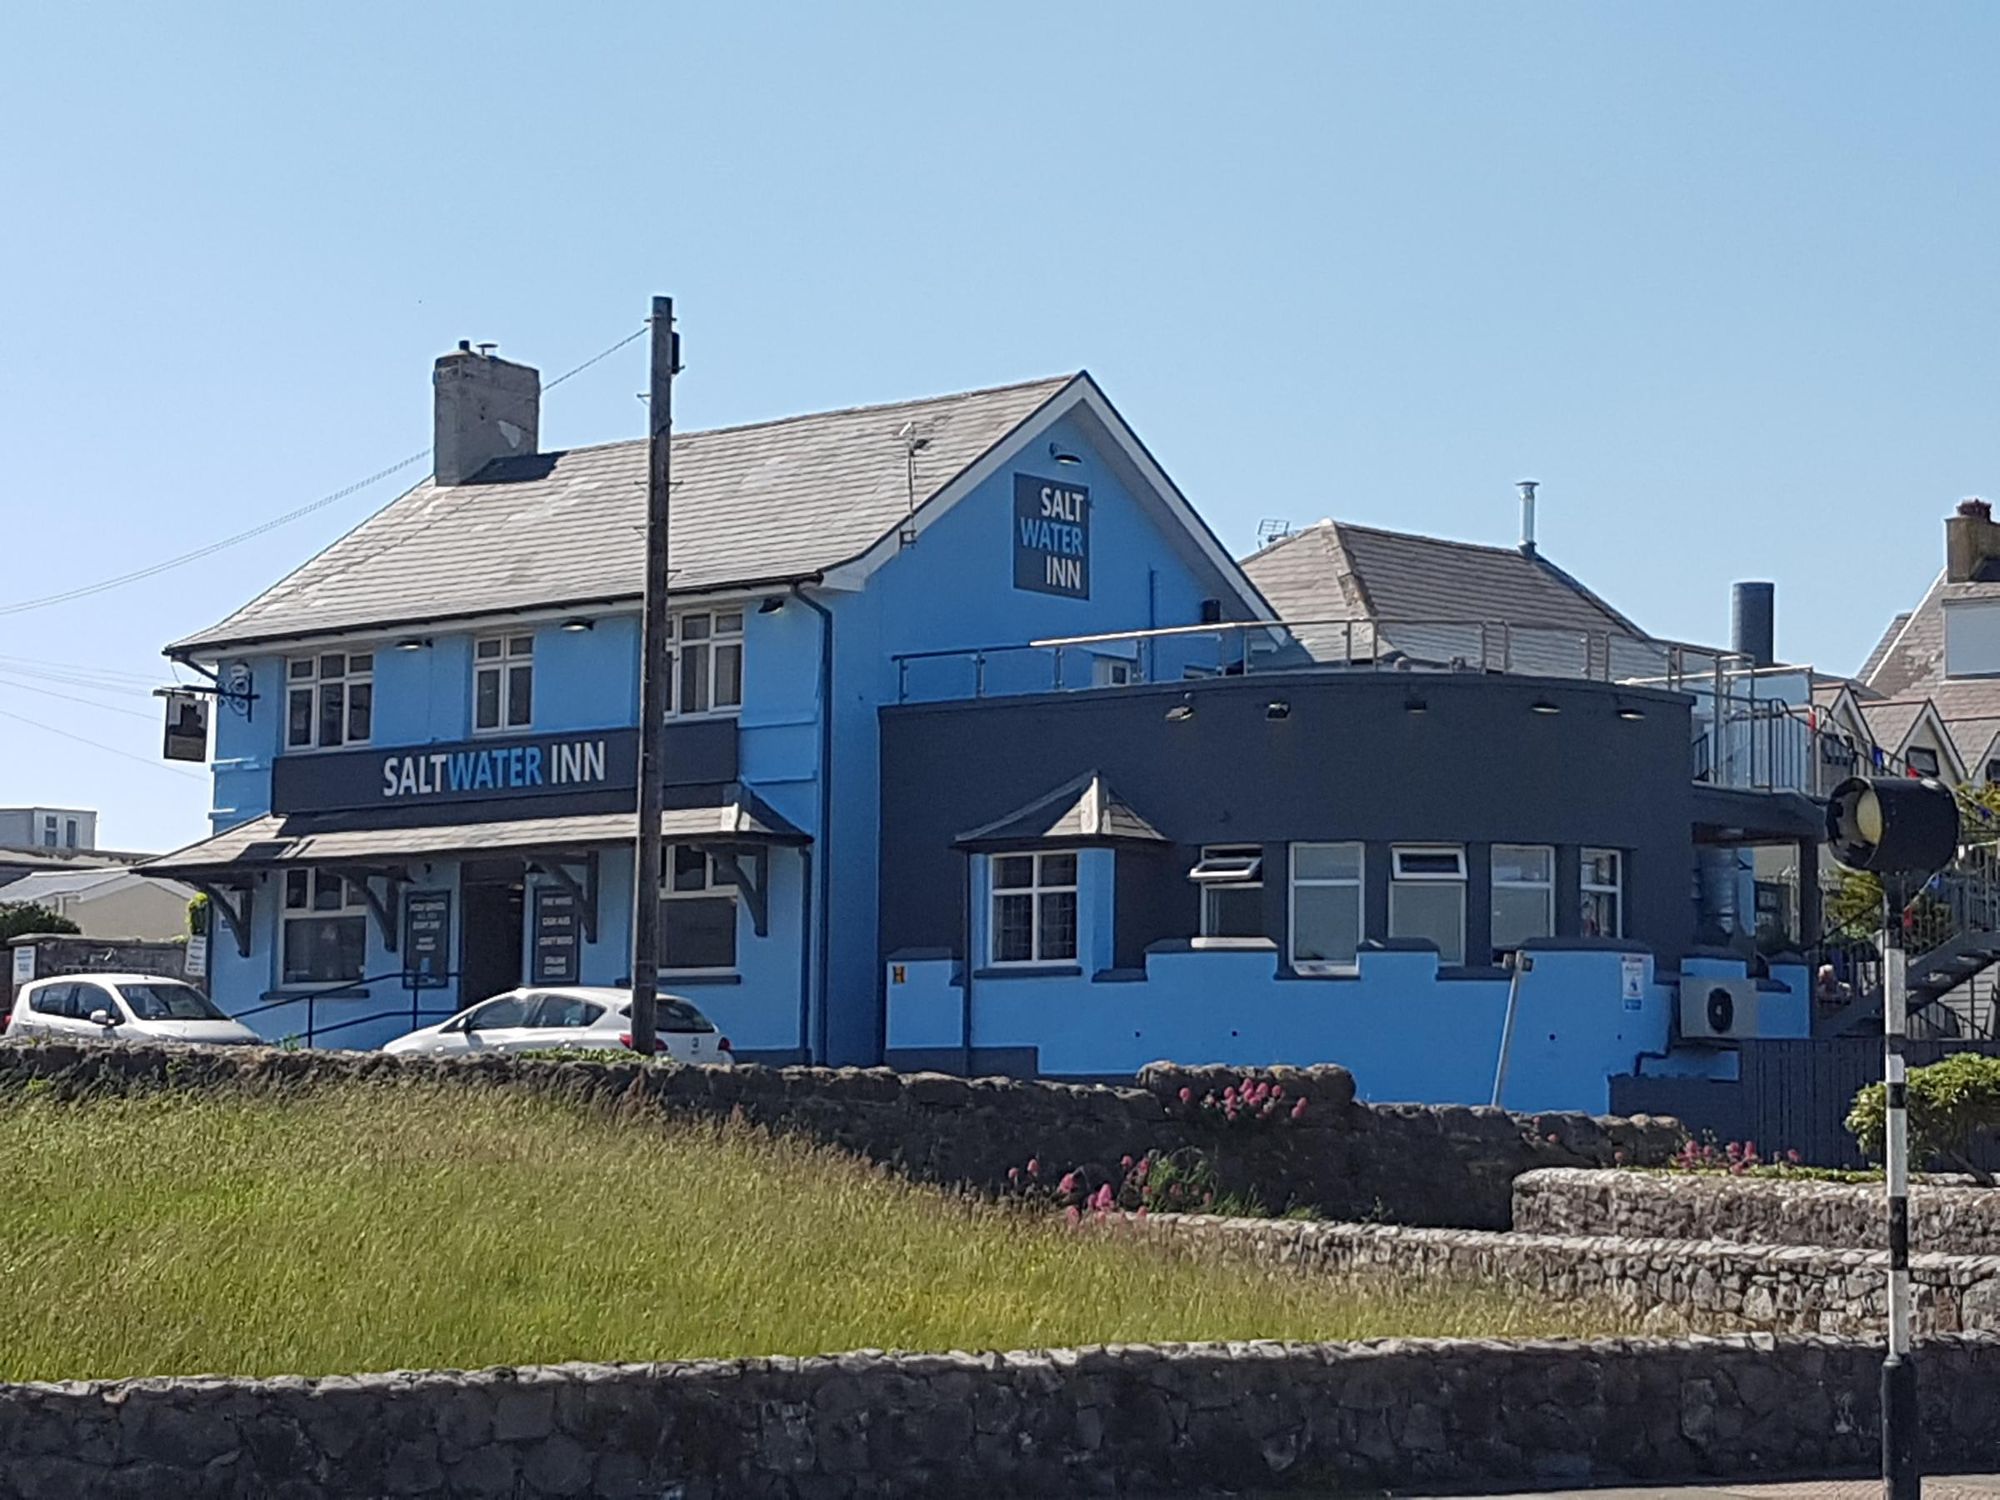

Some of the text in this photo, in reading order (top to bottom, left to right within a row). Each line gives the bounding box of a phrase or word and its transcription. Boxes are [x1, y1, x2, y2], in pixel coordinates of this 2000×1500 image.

[1041, 487, 1084, 522] SALT
[1020, 517, 1084, 556] WATER
[1046, 555, 1081, 589] INN
[551, 741, 605, 784] INN
